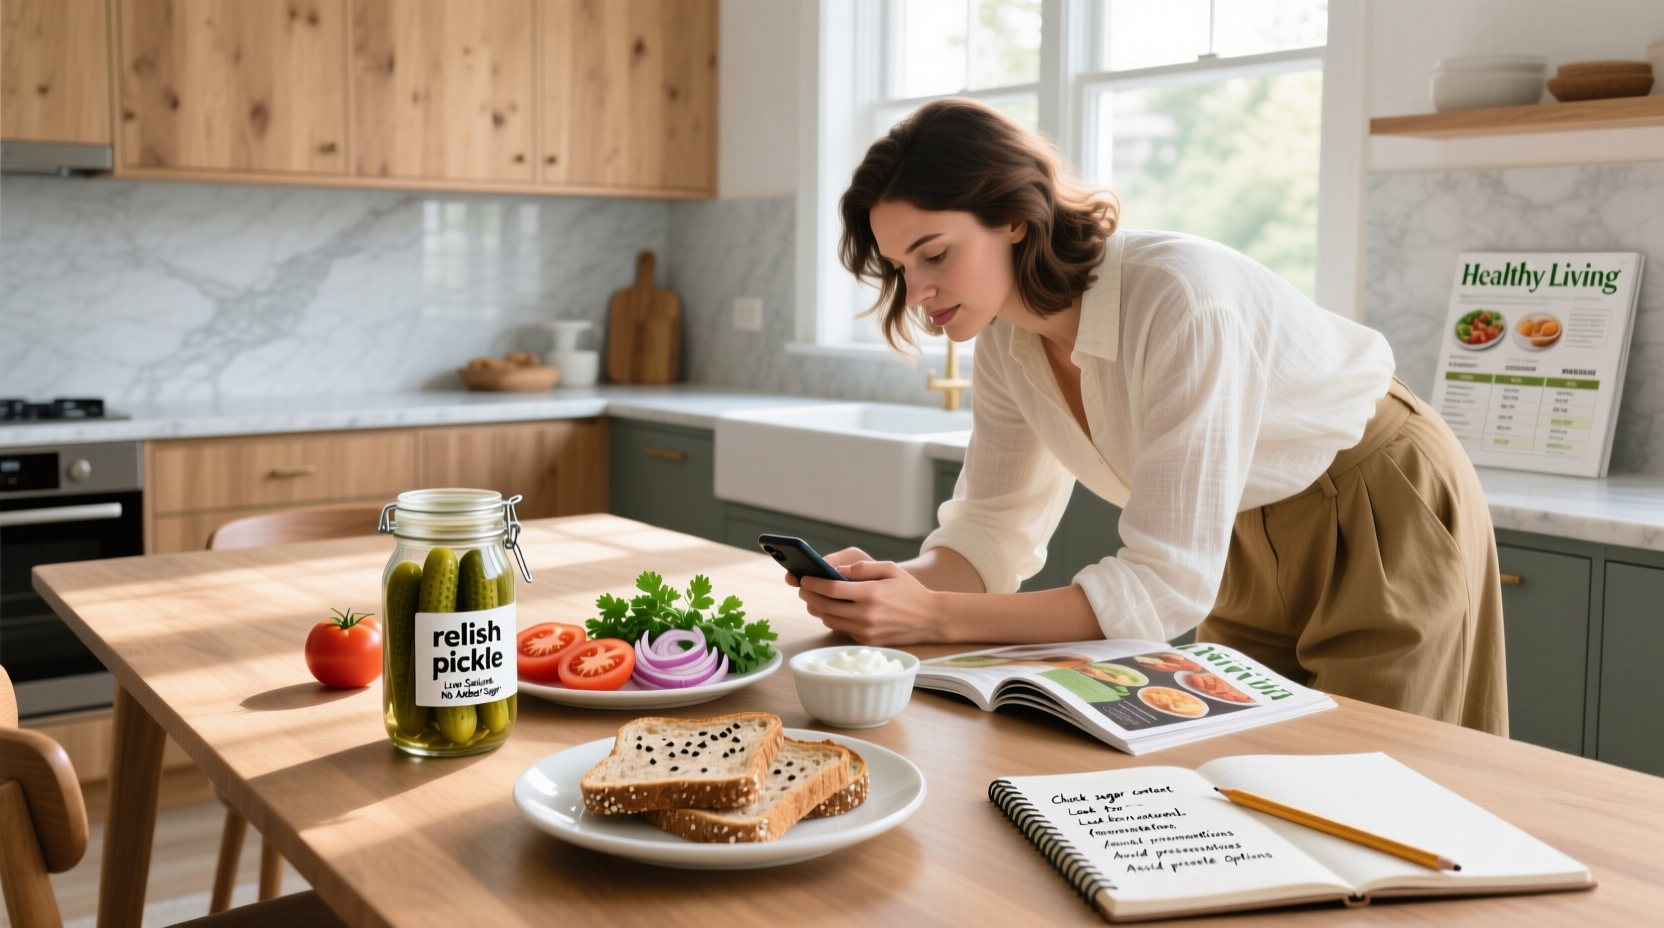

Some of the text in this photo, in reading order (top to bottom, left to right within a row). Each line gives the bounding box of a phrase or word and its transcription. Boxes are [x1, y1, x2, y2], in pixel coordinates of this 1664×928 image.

[1461, 262, 1622, 295] Healthy Living
[433, 620, 501, 647] relish
[433, 647, 503, 681] pickle
